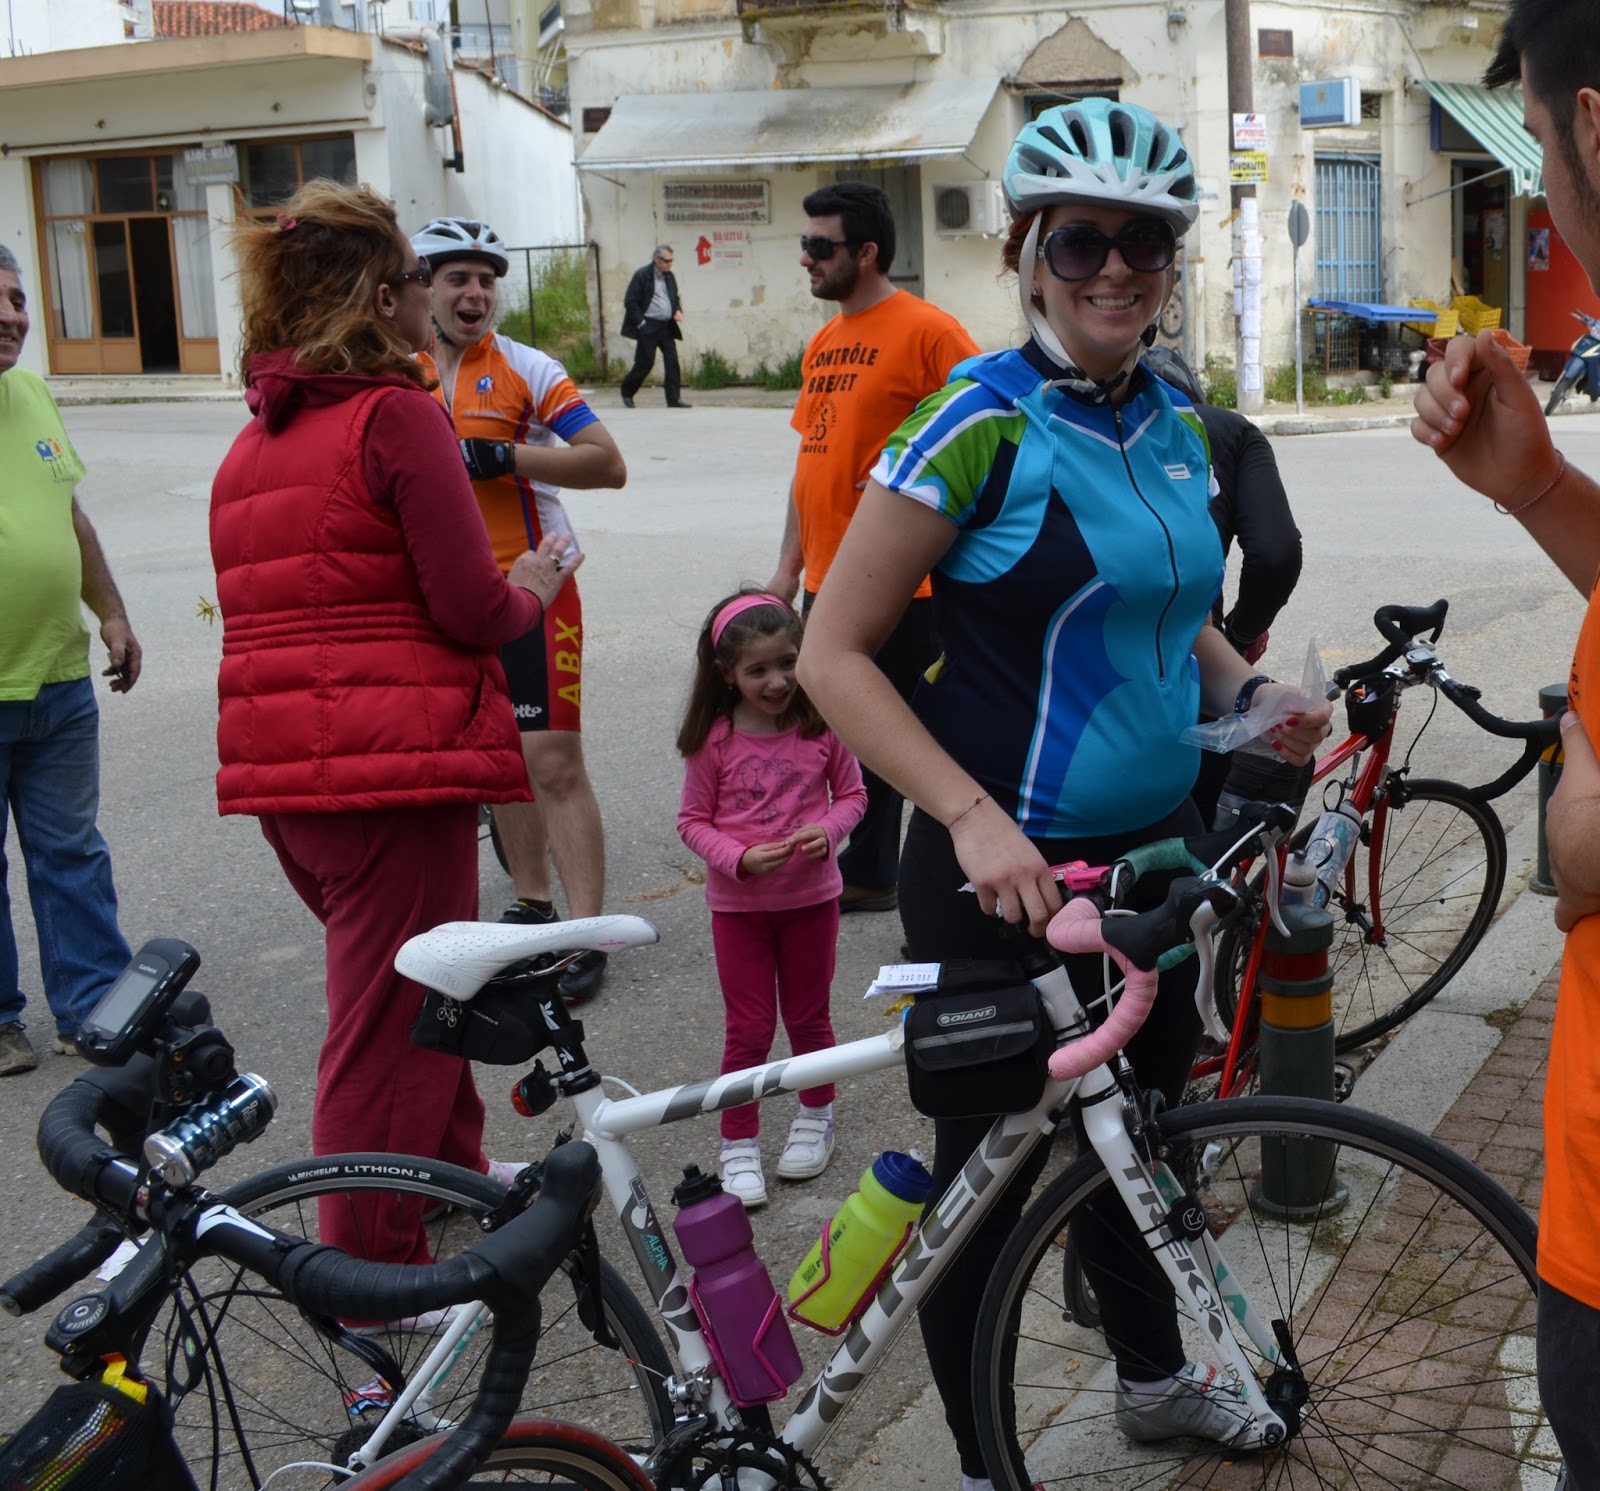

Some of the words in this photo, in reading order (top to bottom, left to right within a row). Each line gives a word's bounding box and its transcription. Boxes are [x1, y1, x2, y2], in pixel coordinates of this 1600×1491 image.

[555, 616, 581, 709] ABX
[949, 1007, 993, 1023] GIANT
[297, 1166, 339, 1180] MICHELIN
[344, 1165, 431, 1180] LITHION.2
[647, 1234, 669, 1272] ALPHA
